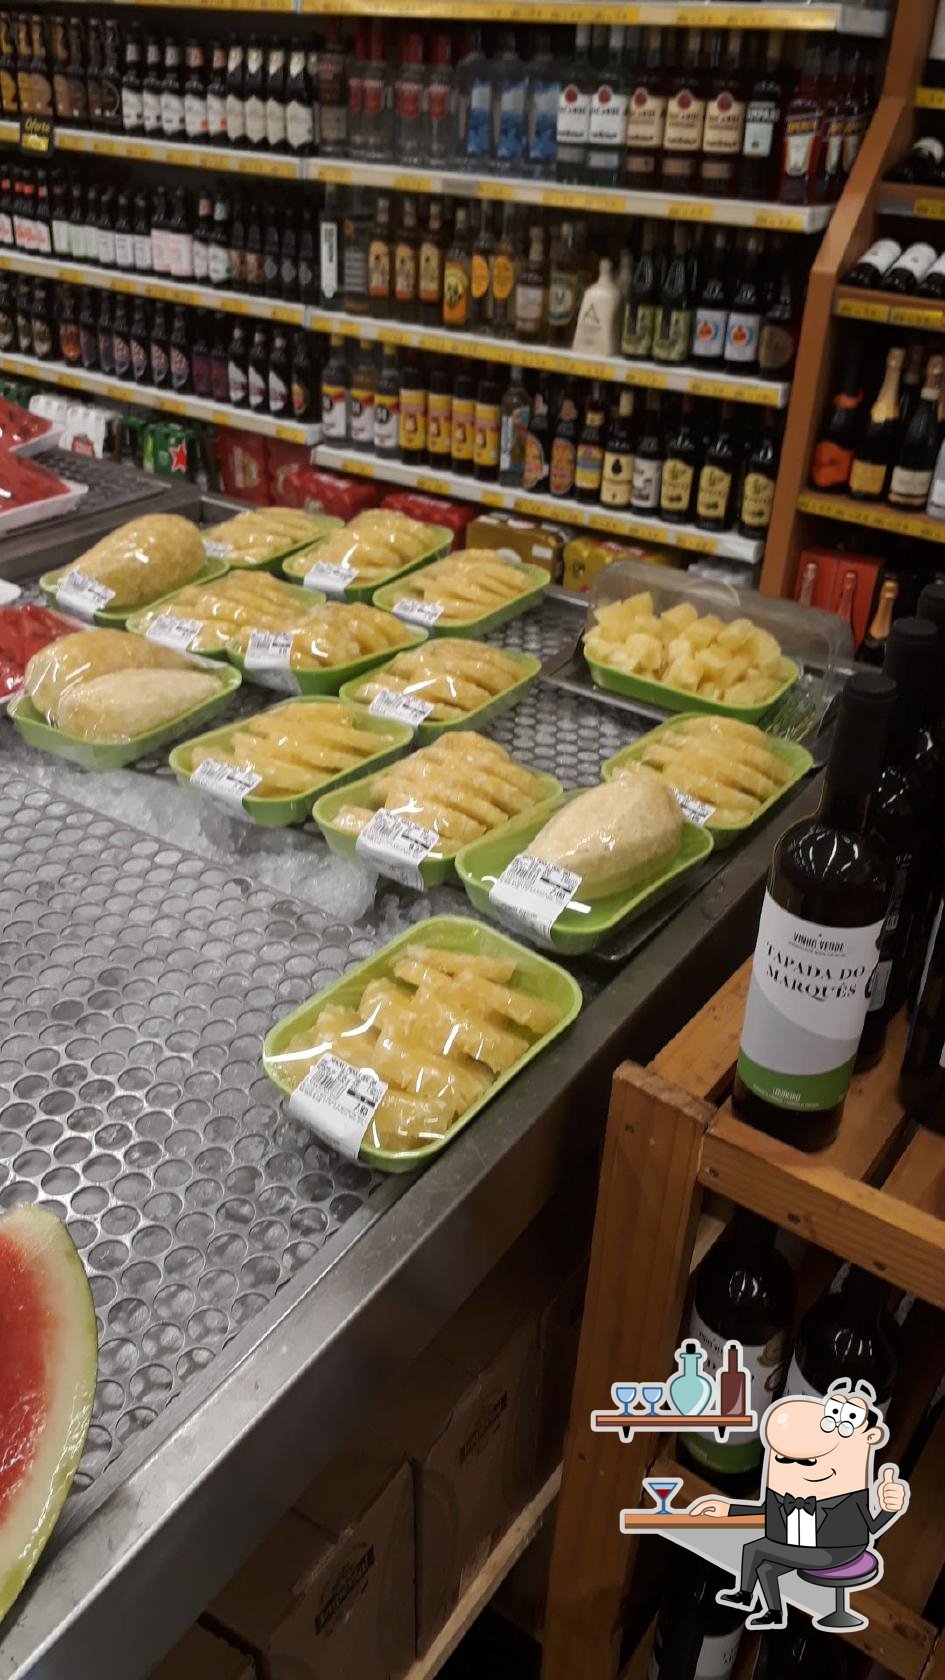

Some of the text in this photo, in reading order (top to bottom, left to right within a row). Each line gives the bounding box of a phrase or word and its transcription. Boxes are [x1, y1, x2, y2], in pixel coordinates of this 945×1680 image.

[766, 941, 832, 980] TAPADA
[839, 965, 866, 980] DO
[793, 931, 818, 949] VINHO
[819, 940, 844, 952] VERDE
[765, 964, 857, 1002] MARQUÊS
